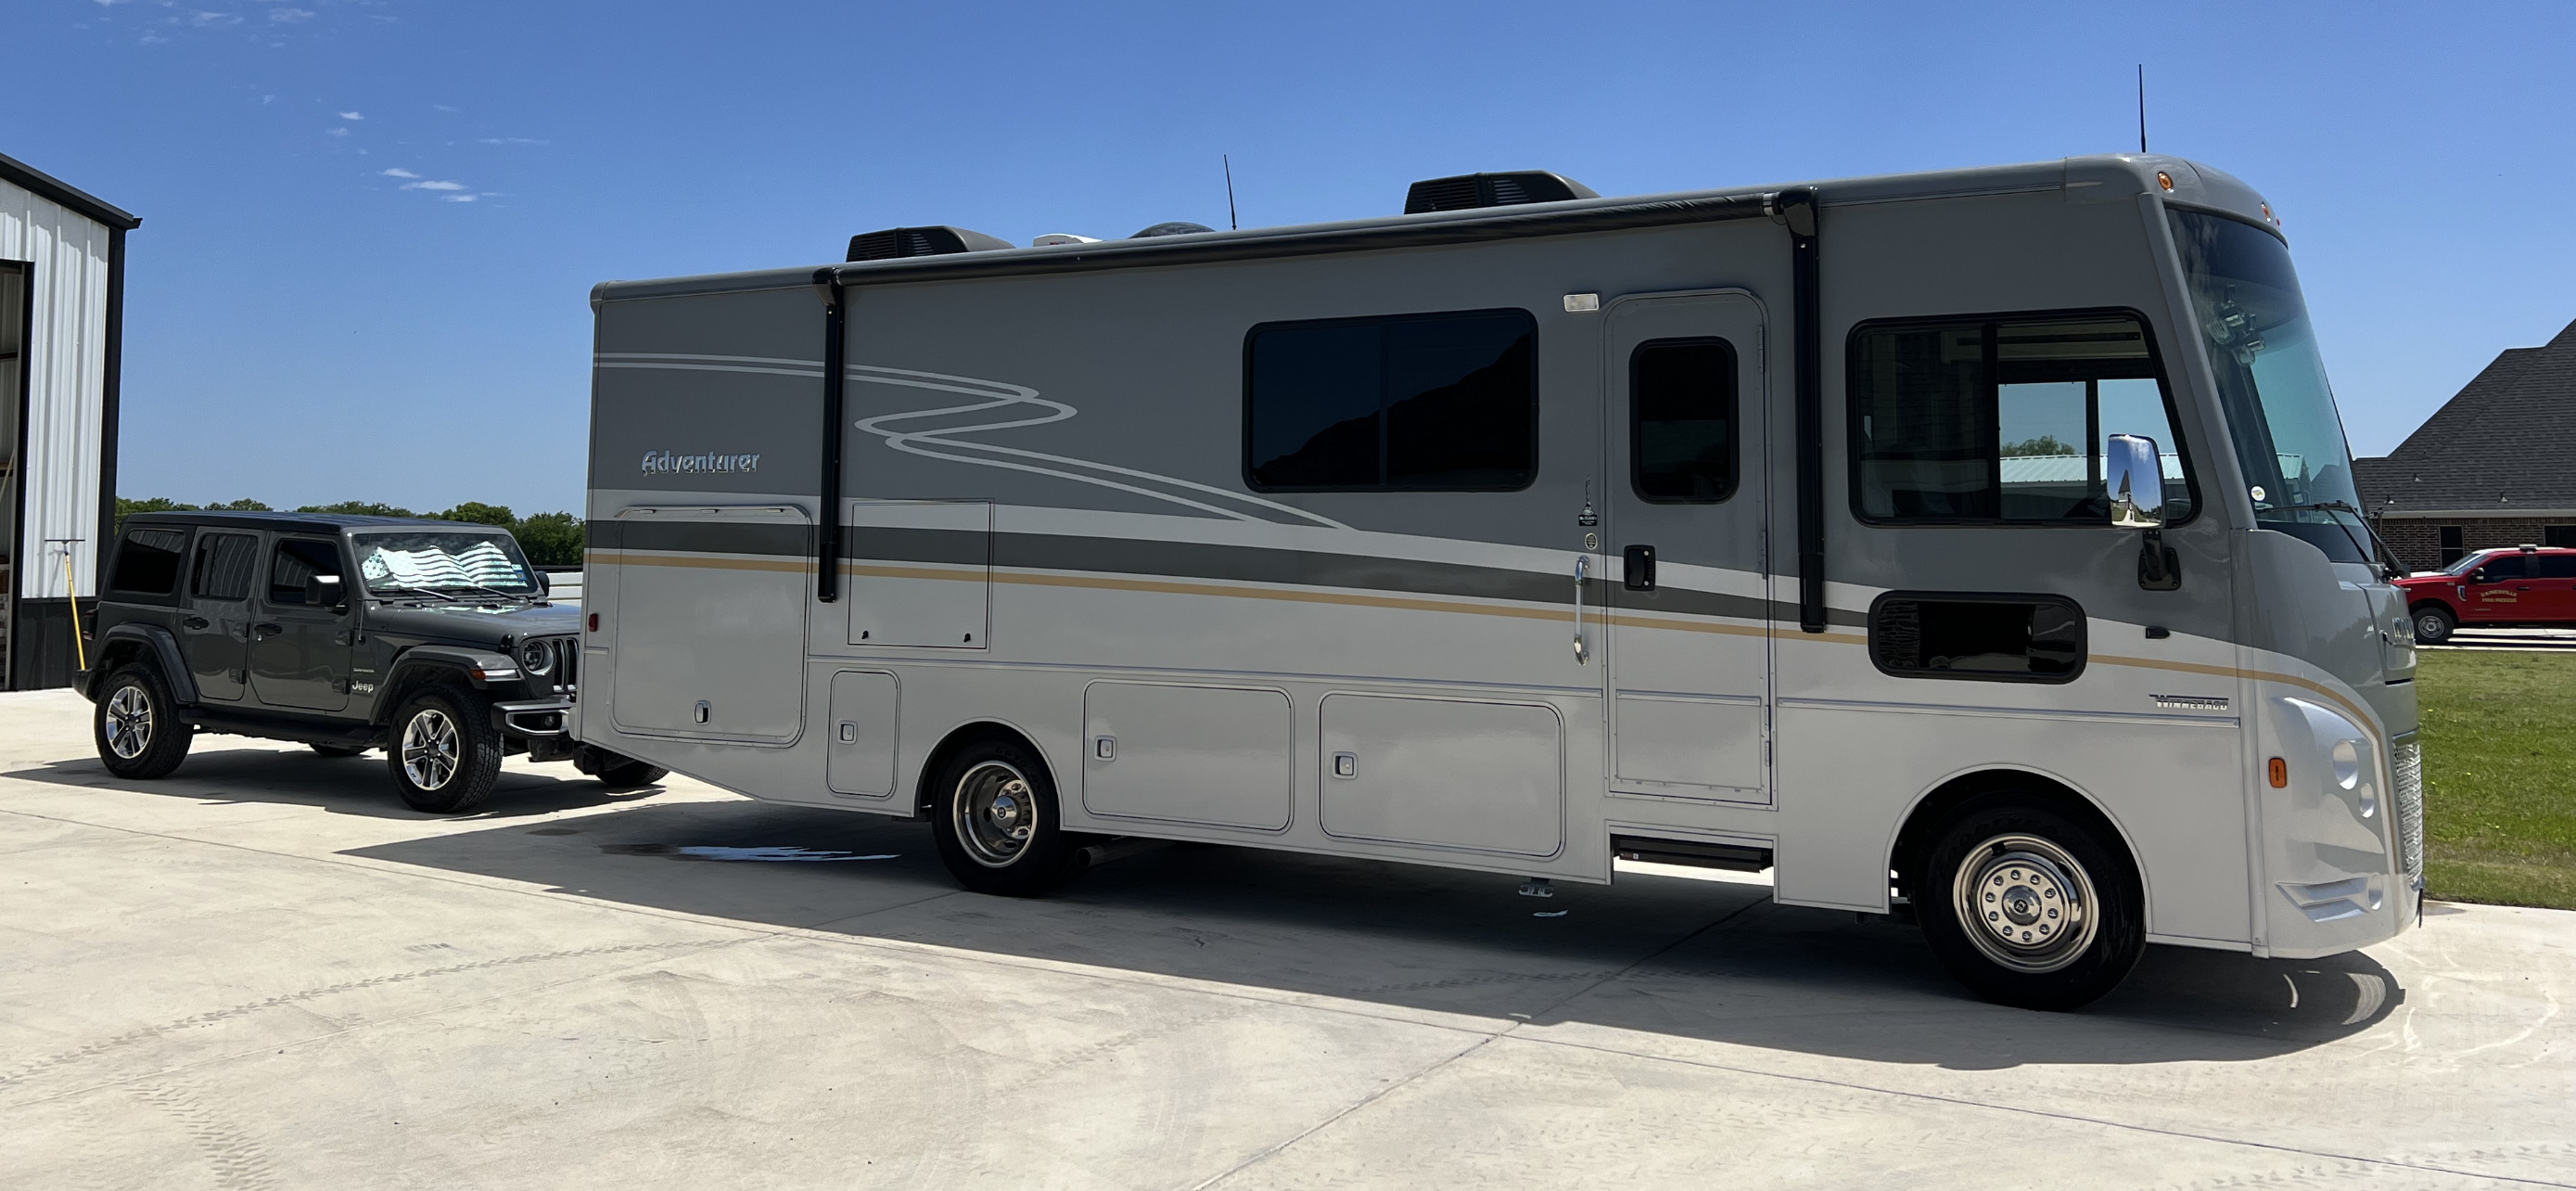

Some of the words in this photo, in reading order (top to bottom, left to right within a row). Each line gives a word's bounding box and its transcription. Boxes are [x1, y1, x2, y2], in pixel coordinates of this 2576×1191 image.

[641, 450, 760, 477] Adventurer
[352, 680, 374, 693] Jeep
[2149, 694, 2229, 711] WINNEBAGO
